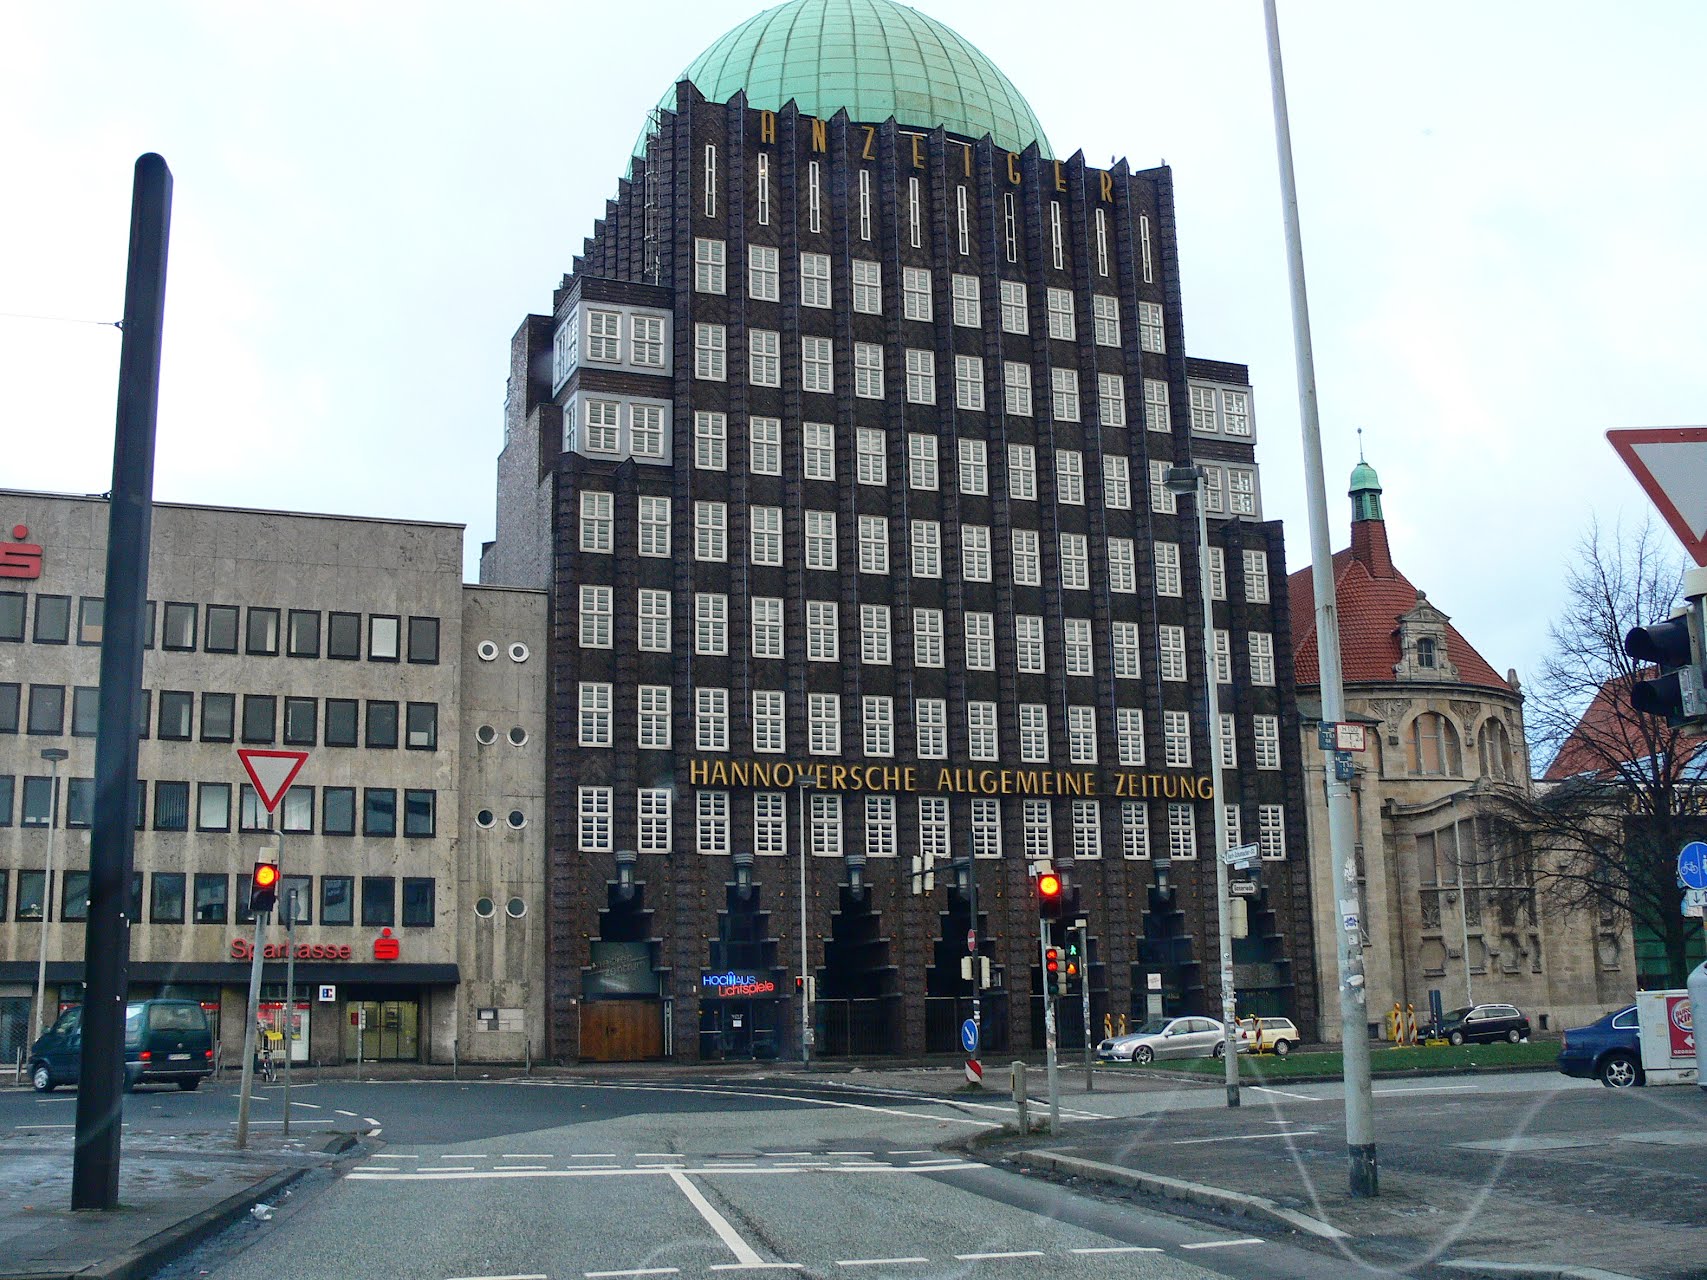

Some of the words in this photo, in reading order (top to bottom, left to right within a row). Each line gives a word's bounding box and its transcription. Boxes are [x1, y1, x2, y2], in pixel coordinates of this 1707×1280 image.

[761, 110, 1113, 203] ANZEIGER
[689, 759, 916, 791] HANNOVERSCHE
[937, 768, 1095, 796] ALLGEMEINE
[1114, 772, 1214, 800] ZEITUNG
[718, 979, 776, 998] Lichtspiele
